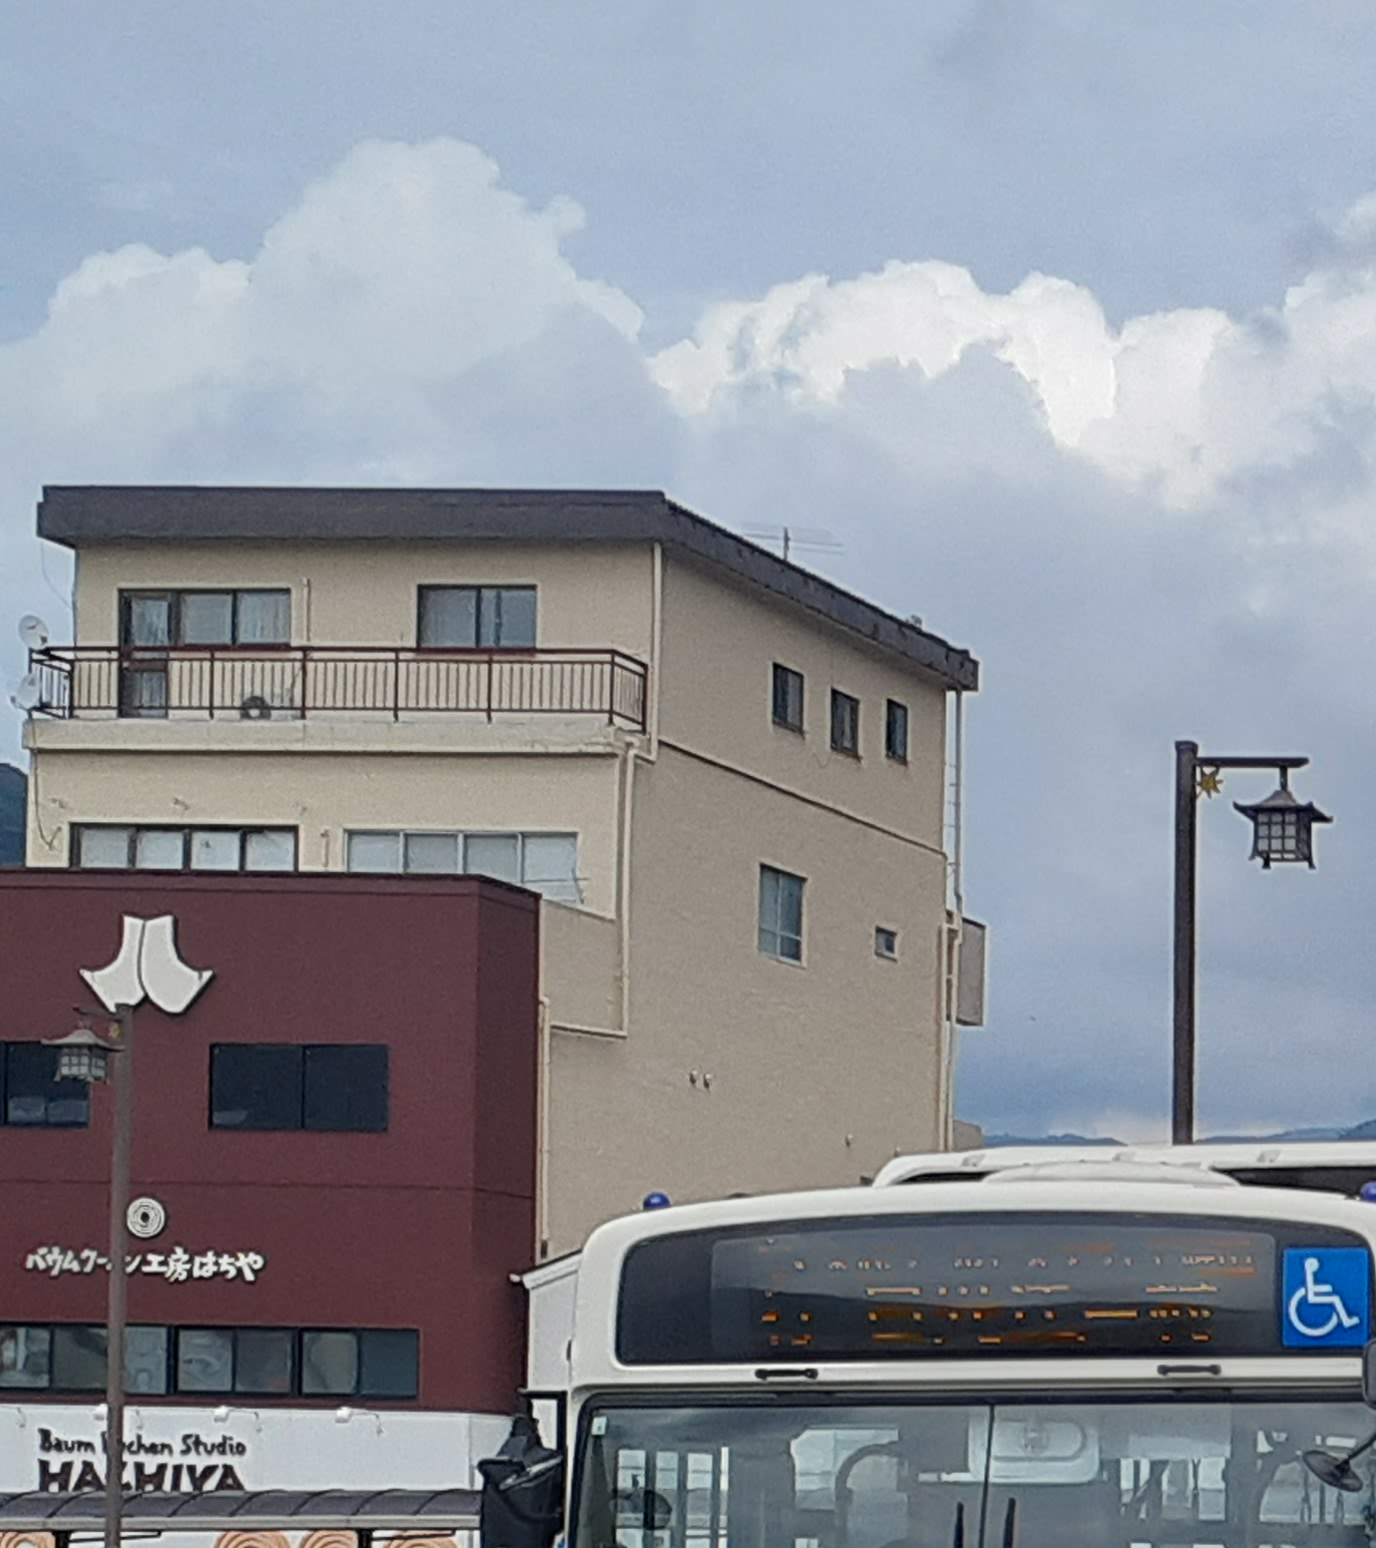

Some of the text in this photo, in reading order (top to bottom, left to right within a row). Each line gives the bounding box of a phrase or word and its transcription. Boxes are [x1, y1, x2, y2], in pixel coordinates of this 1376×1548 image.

[25, 1245, 266, 1283] バウムクーン工房はちや
[37, 1427, 97, 1455] Baum
[179, 1433, 248, 1457] Studio
